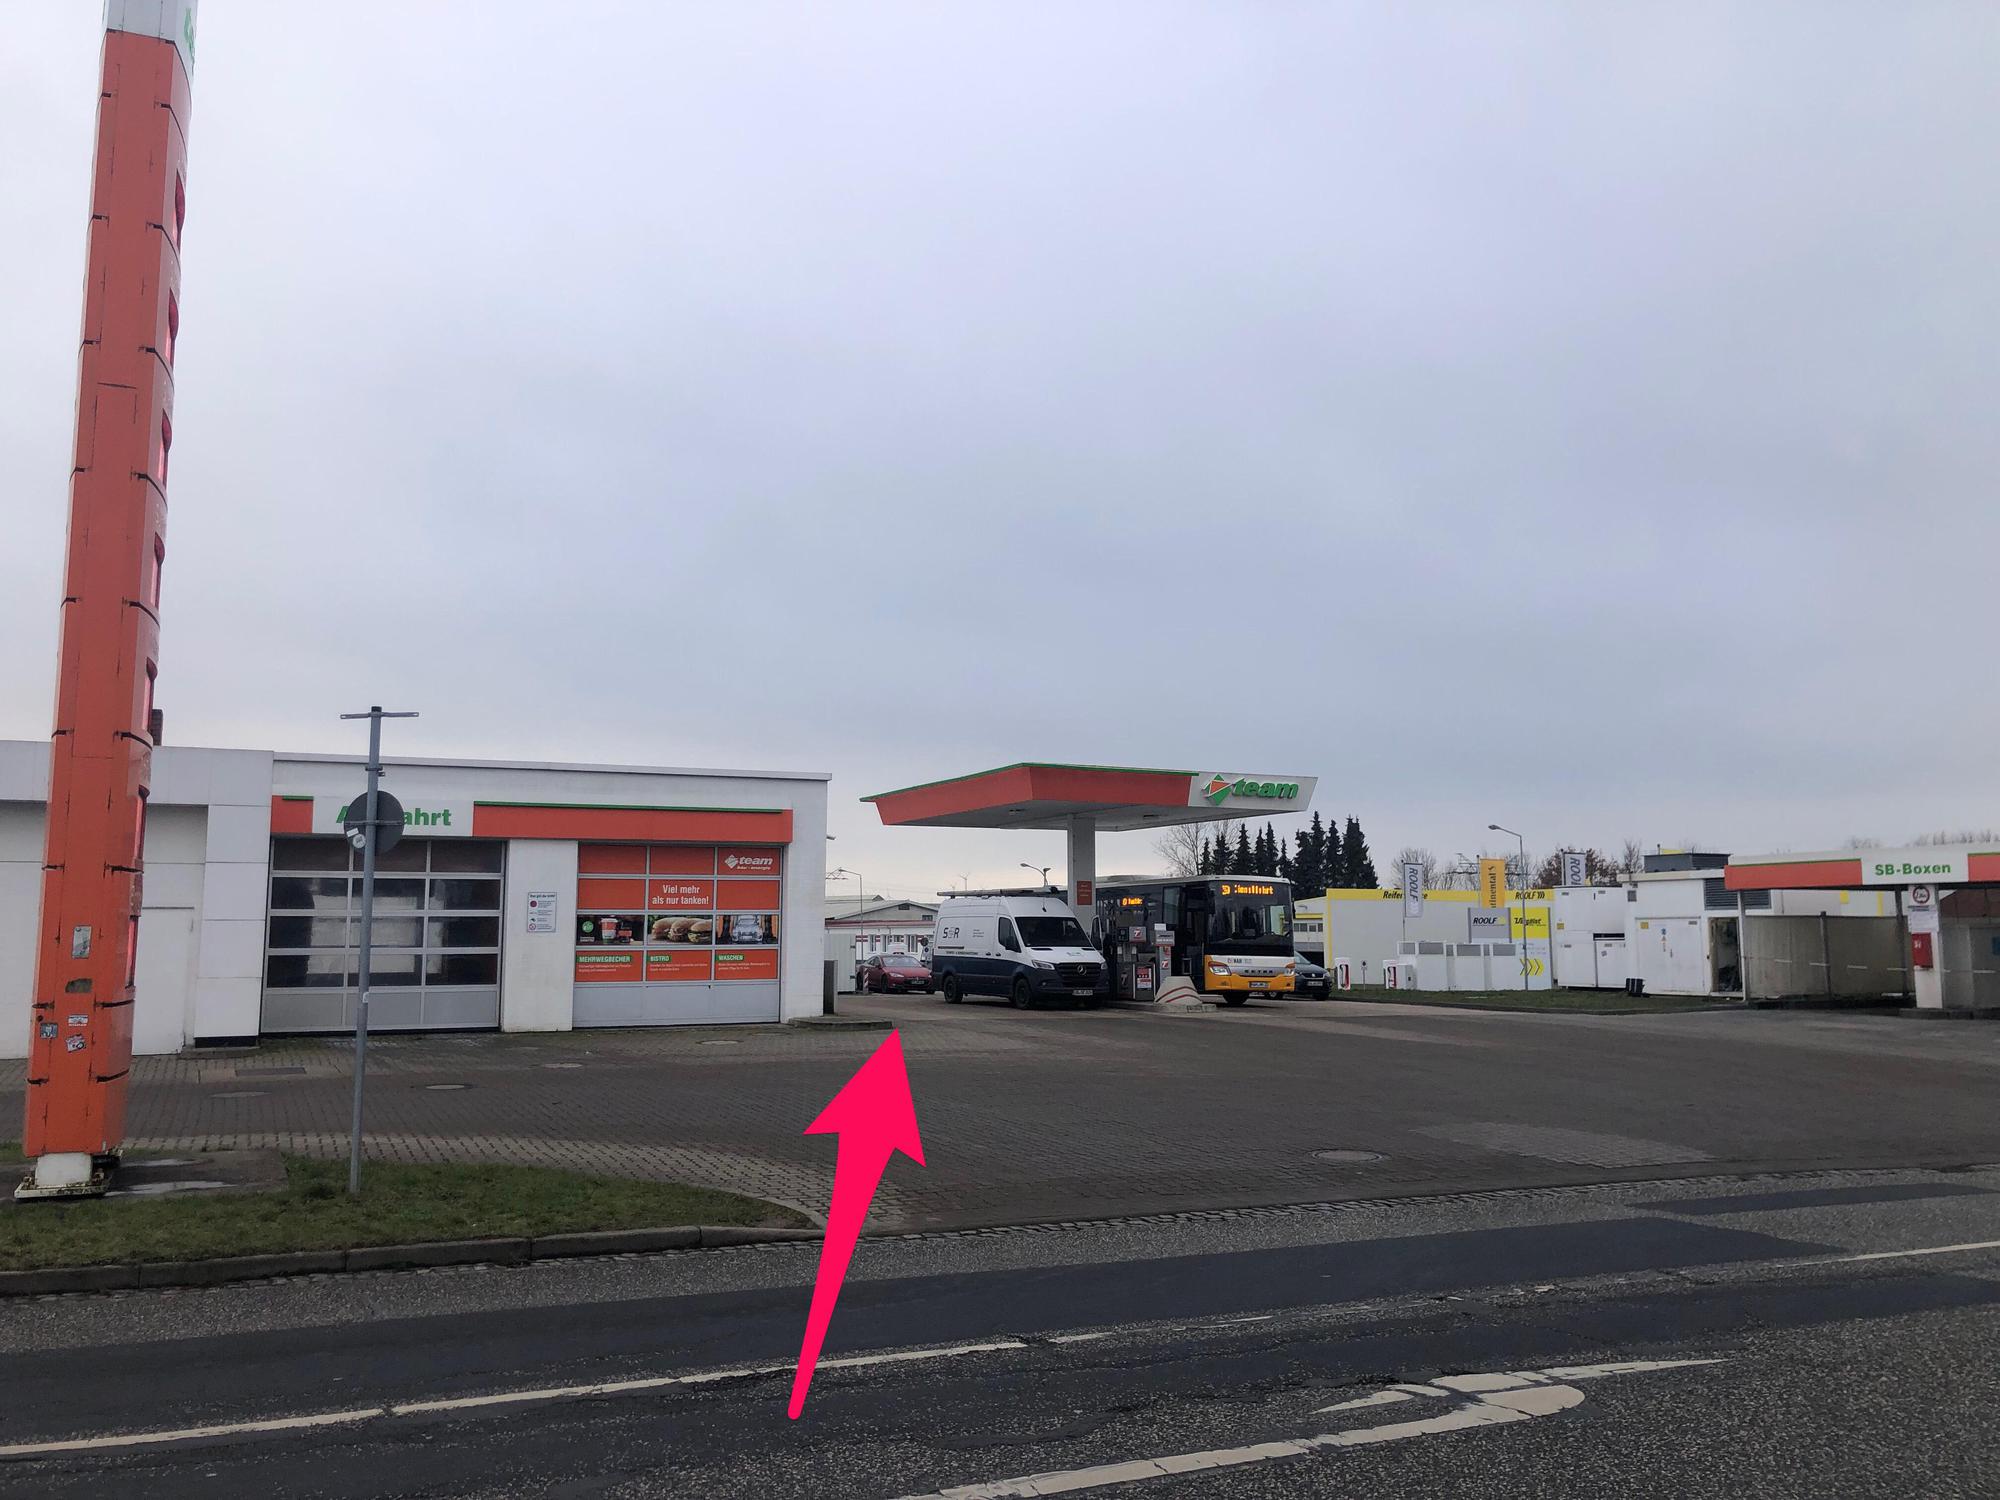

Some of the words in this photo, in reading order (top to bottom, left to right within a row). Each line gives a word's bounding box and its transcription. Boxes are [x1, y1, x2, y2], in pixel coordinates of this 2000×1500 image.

[1232, 778, 1299, 799] team
[336, 806, 452, 826] ahrt
[739, 856, 773, 865] team
[1874, 863, 1952, 876] SB-Boxen
[663, 884, 678, 894] Viel
[680, 884, 701, 894] mehr
[1409, 867, 1419, 902] ROOLF
[652, 895, 664, 905] als
[666, 896, 679, 905] nur
[681, 895, 709, 905] tanken!
[1473, 917, 1498, 925] ROOLF
